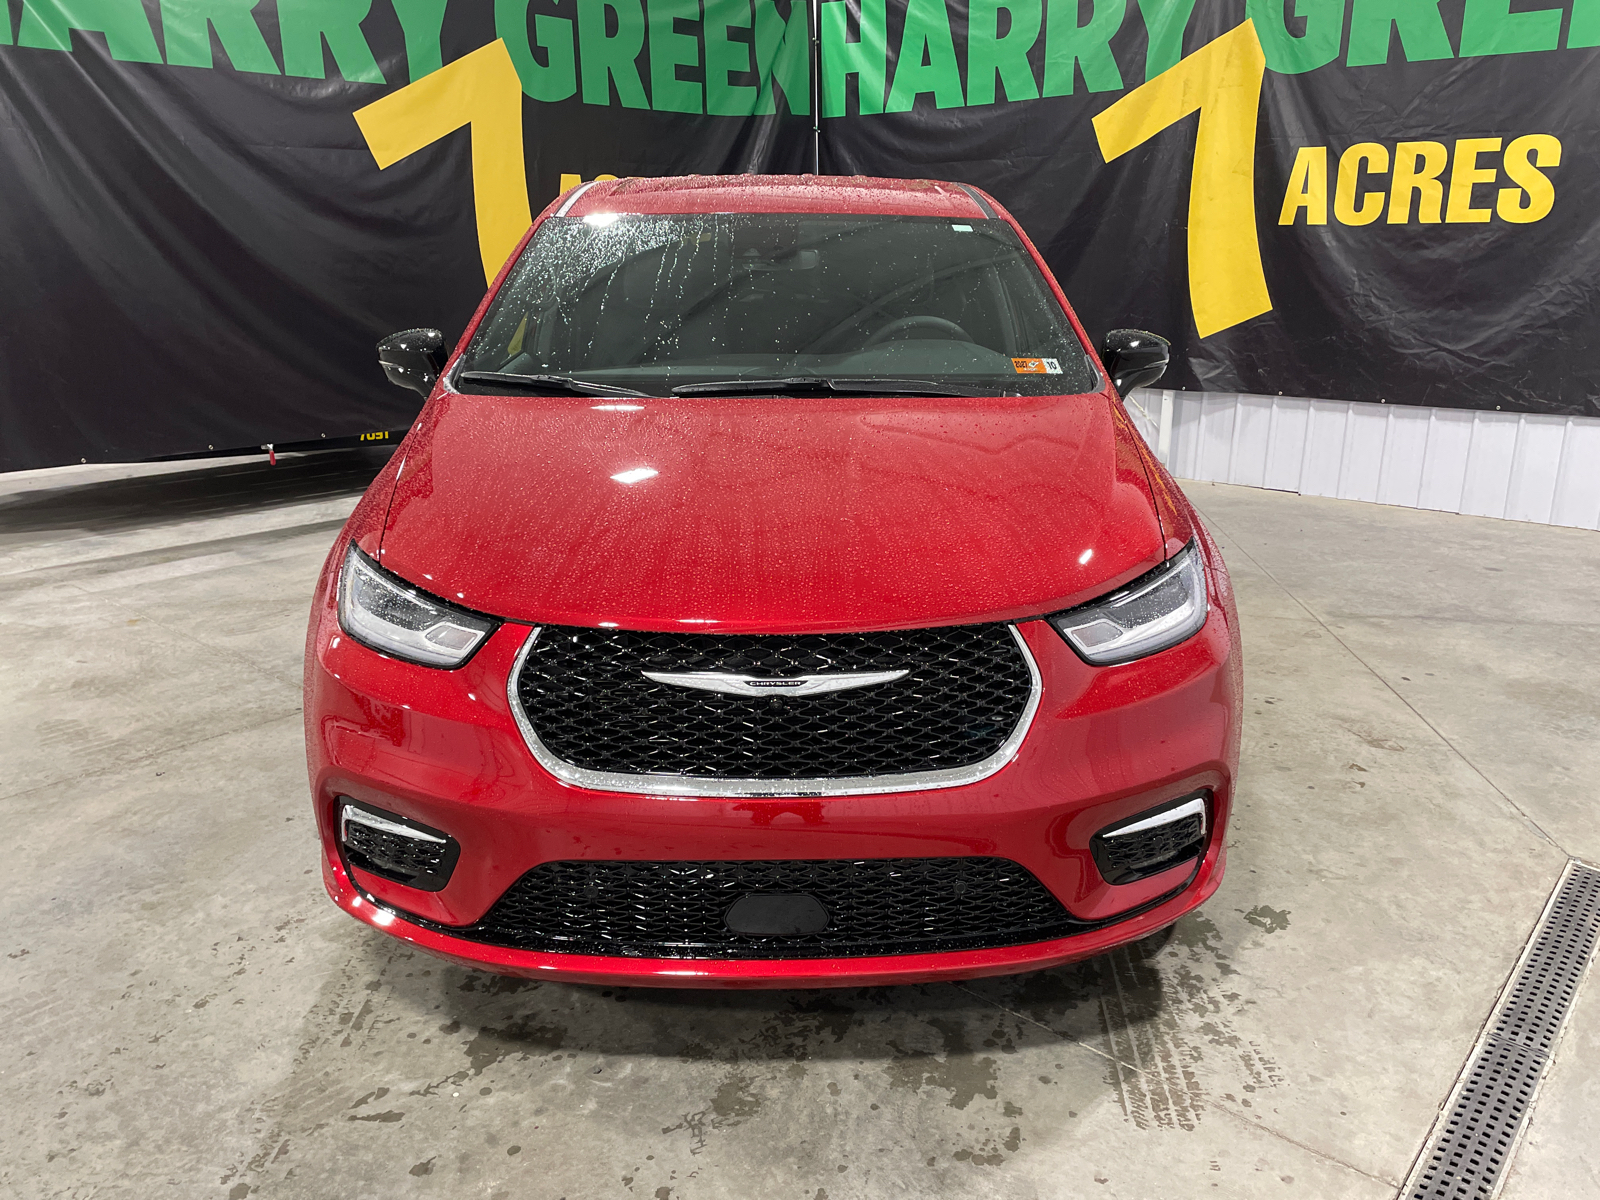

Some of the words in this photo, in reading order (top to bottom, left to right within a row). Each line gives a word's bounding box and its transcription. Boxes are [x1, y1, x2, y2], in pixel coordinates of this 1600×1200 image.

[494, 0, 811, 117] GREEN
[821, 0, 1195, 119] HARRY
[353, 38, 534, 290] 7
[1091, 17, 1274, 339] 7
[1278, 133, 1563, 227] ACRES
